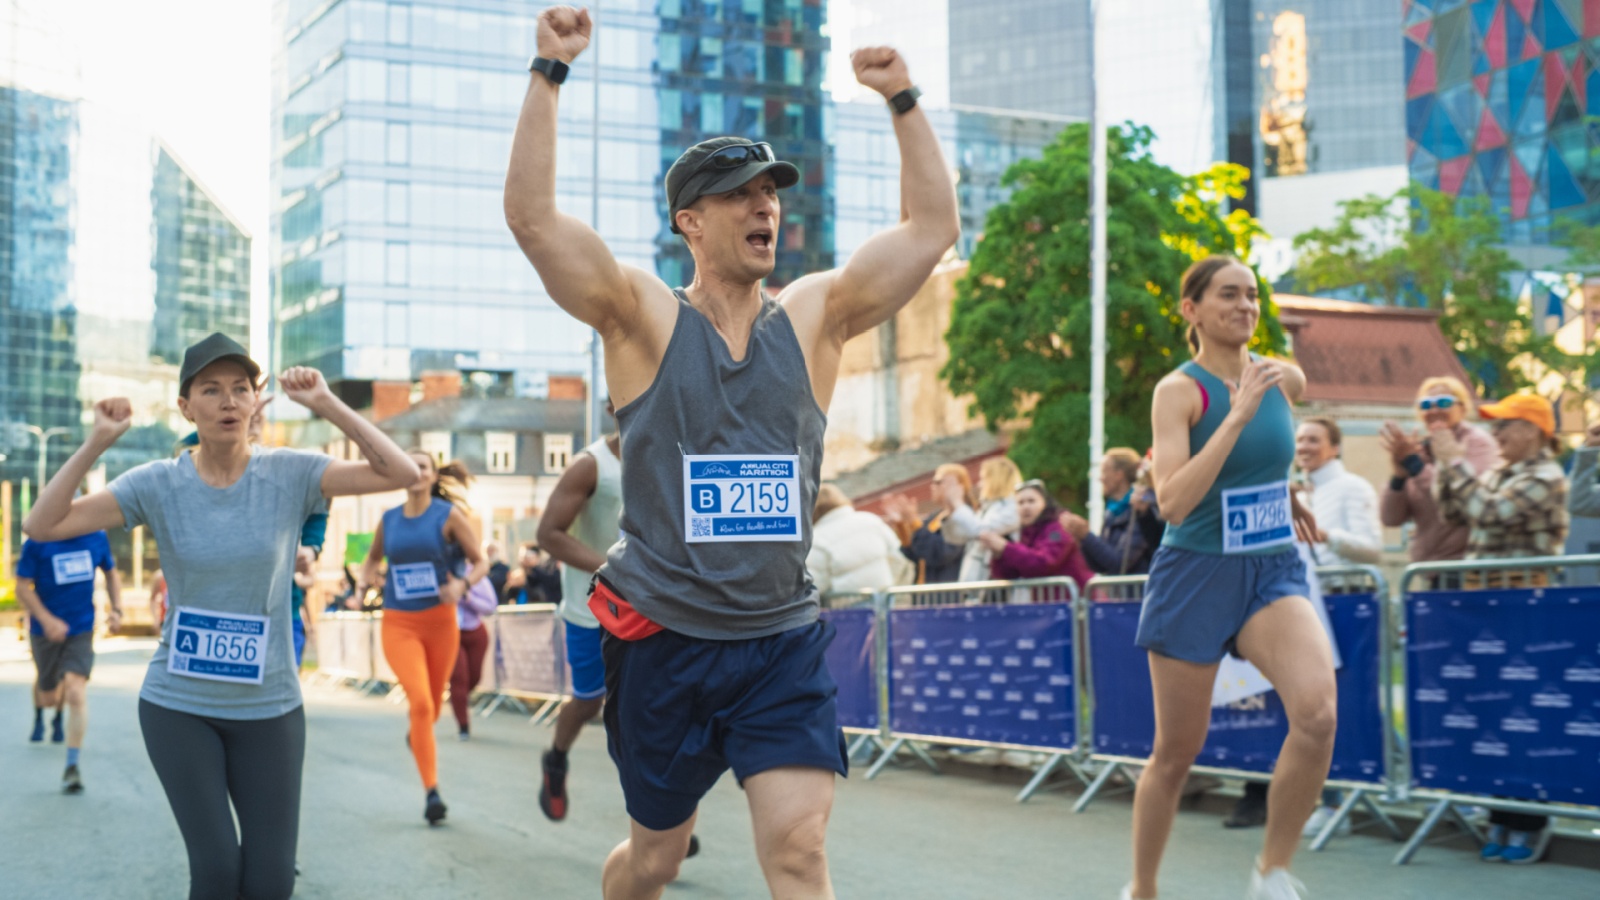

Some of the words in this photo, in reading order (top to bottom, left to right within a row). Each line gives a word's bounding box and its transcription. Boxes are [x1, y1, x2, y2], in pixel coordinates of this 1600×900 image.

[699, 489, 715, 509] B
[730, 482, 789, 513] 2159
[1232, 513, 1244, 530] A
[1253, 503, 1286, 530] 1296
[180, 634, 194, 651] A
[205, 633, 258, 662] 1656
